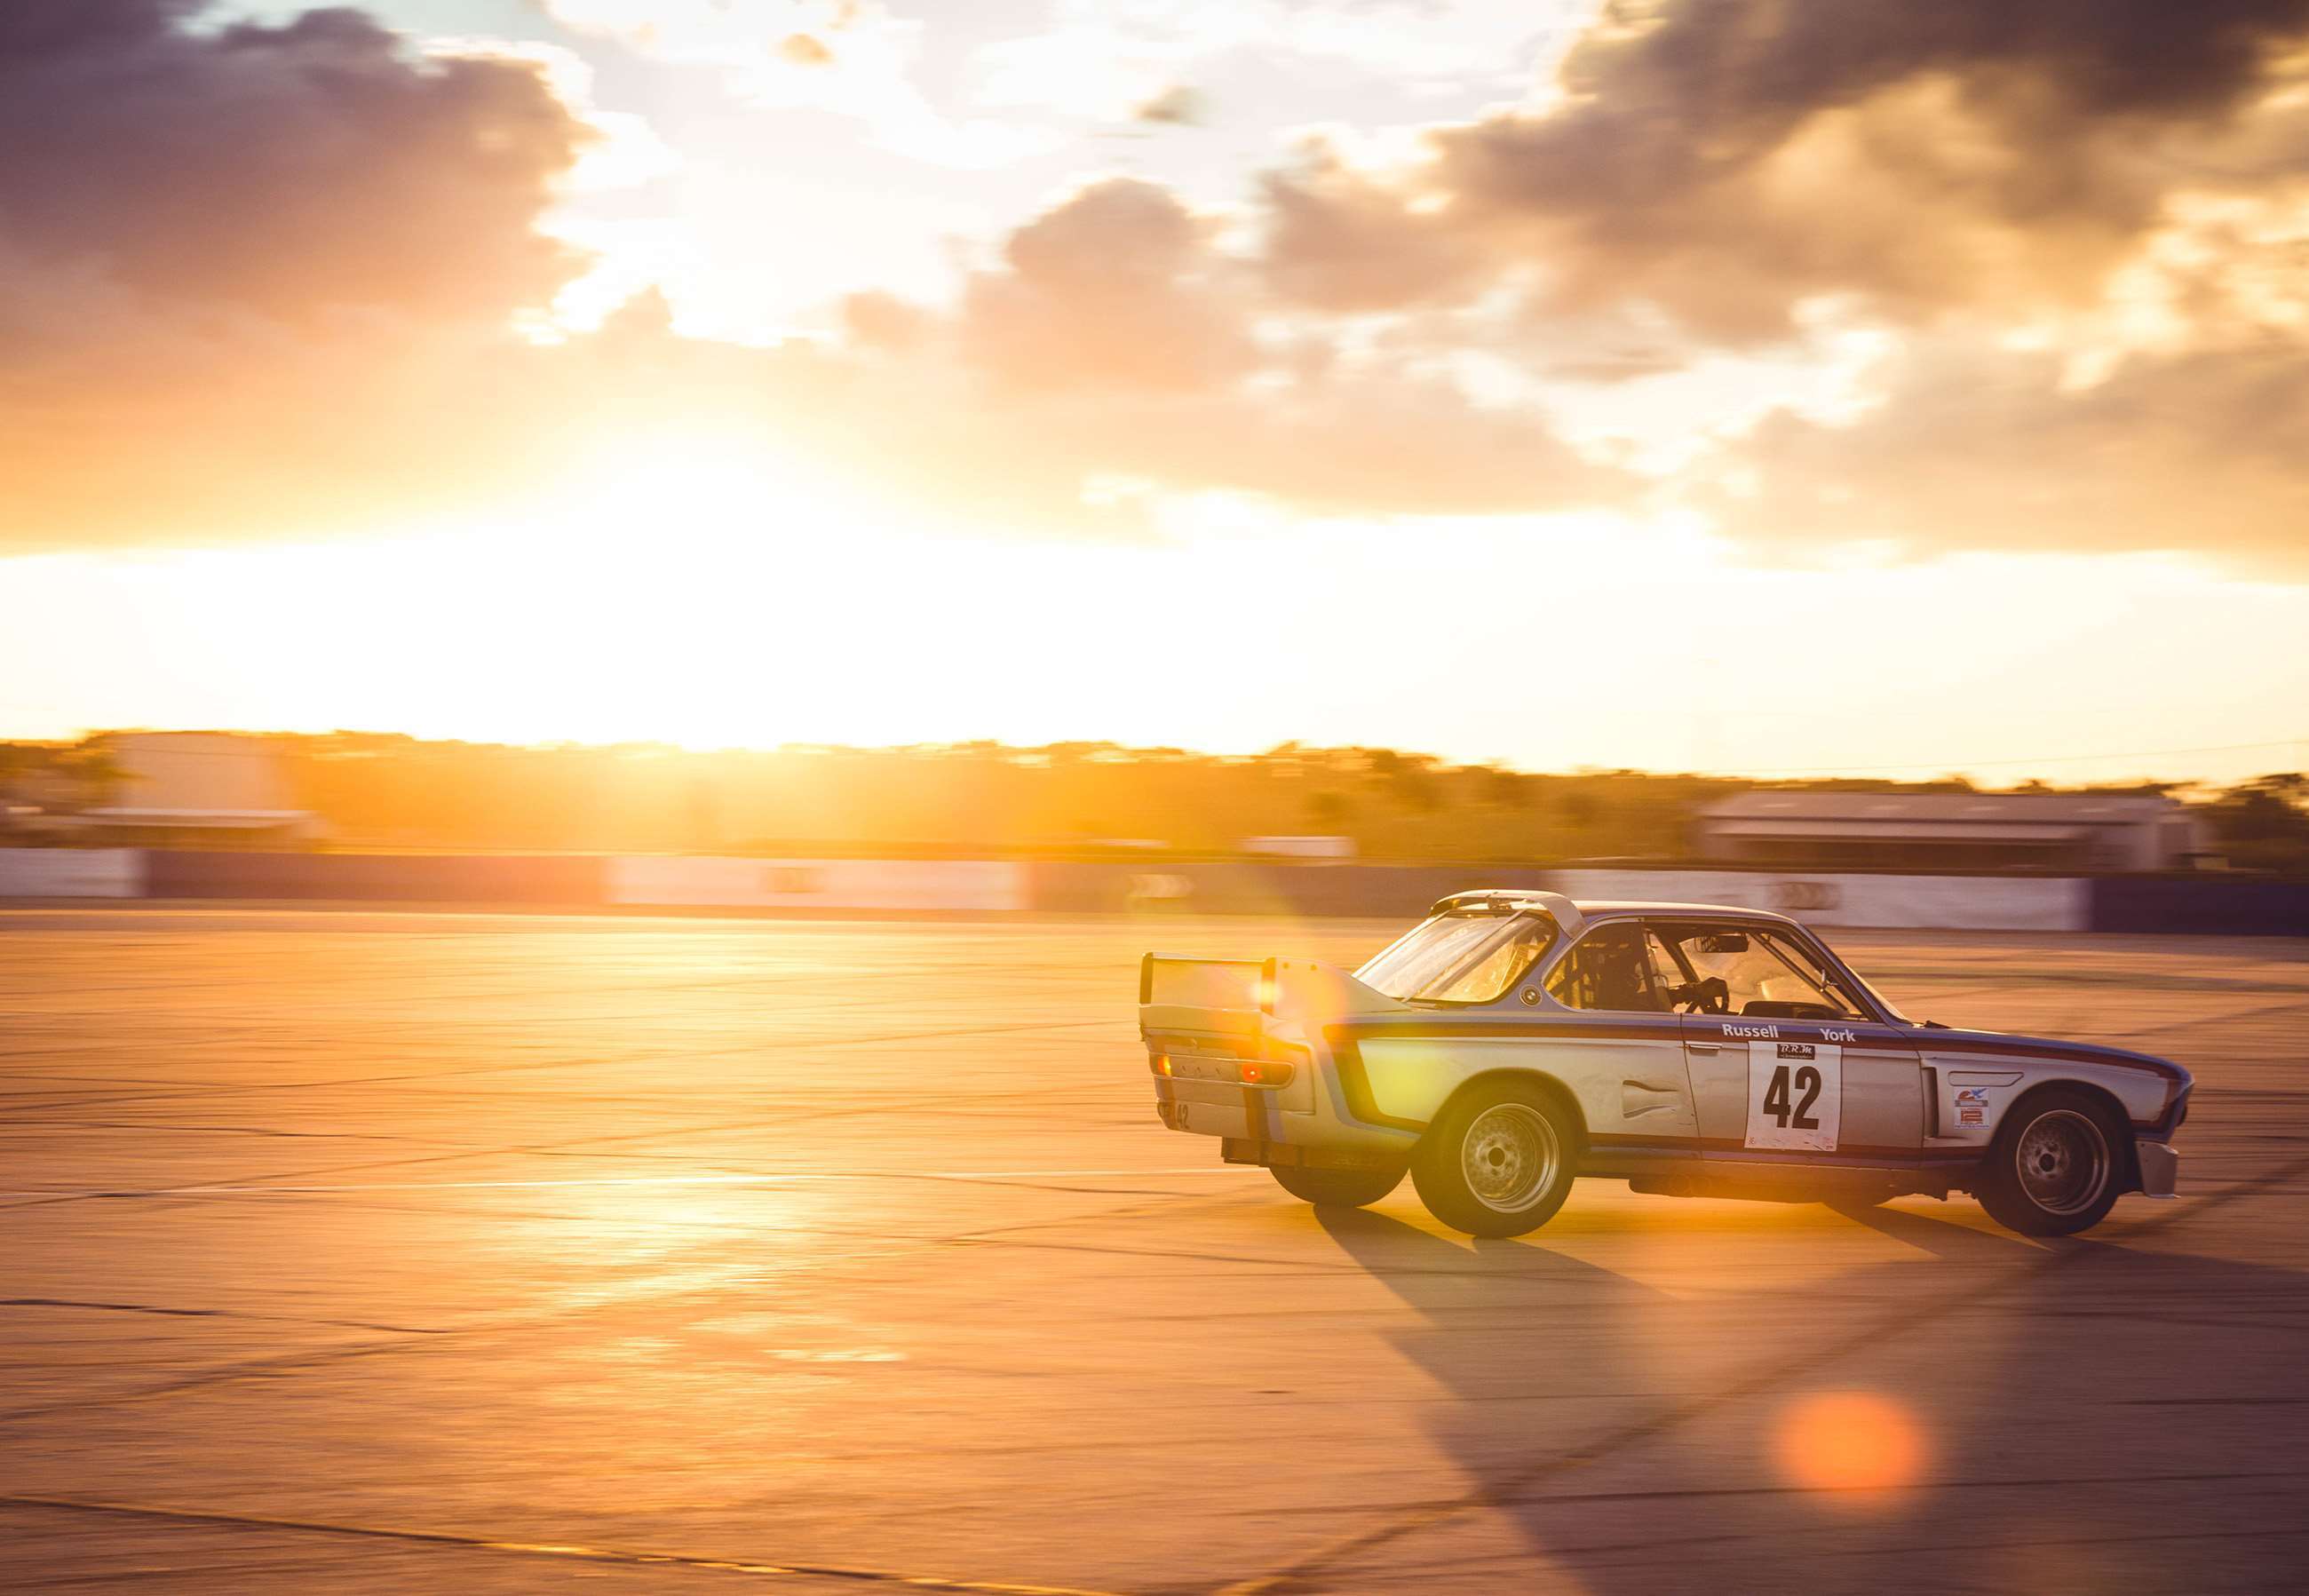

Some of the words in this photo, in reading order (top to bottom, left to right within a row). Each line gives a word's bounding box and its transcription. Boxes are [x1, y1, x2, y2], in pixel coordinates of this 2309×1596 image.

[1722, 1024, 1779, 1038] Russell
[1820, 1028, 1856, 1042] York
[1763, 1066, 1821, 1130] 42
[1177, 1104, 1189, 1130] 42
